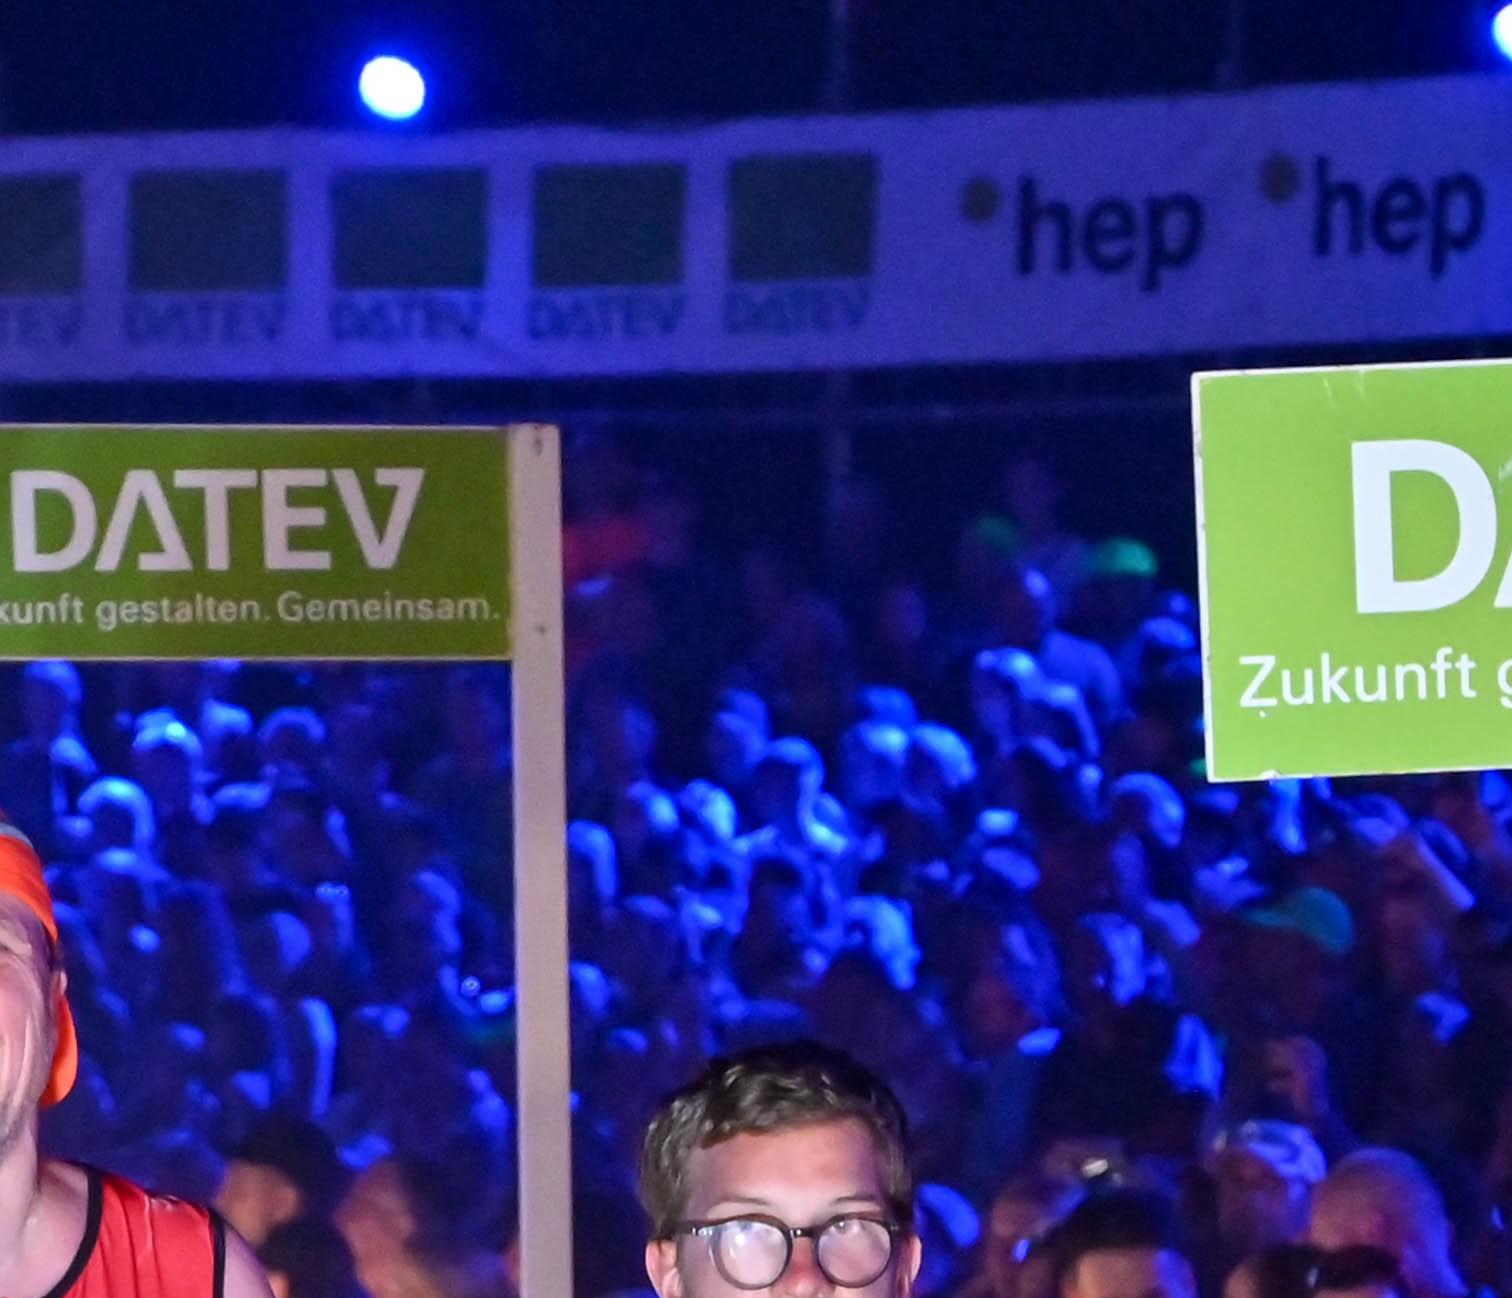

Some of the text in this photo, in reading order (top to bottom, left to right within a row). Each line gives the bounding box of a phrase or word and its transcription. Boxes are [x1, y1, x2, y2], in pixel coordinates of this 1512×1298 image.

[1015, 175, 1205, 292] hep
[1311, 151, 1485, 276] hep
[9, 467, 425, 574] DATEV
[95, 590, 268, 636] gestalten.
[276, 589, 502, 625] Gemeinsam.
[1237, 646, 1478, 711] Zukunft
